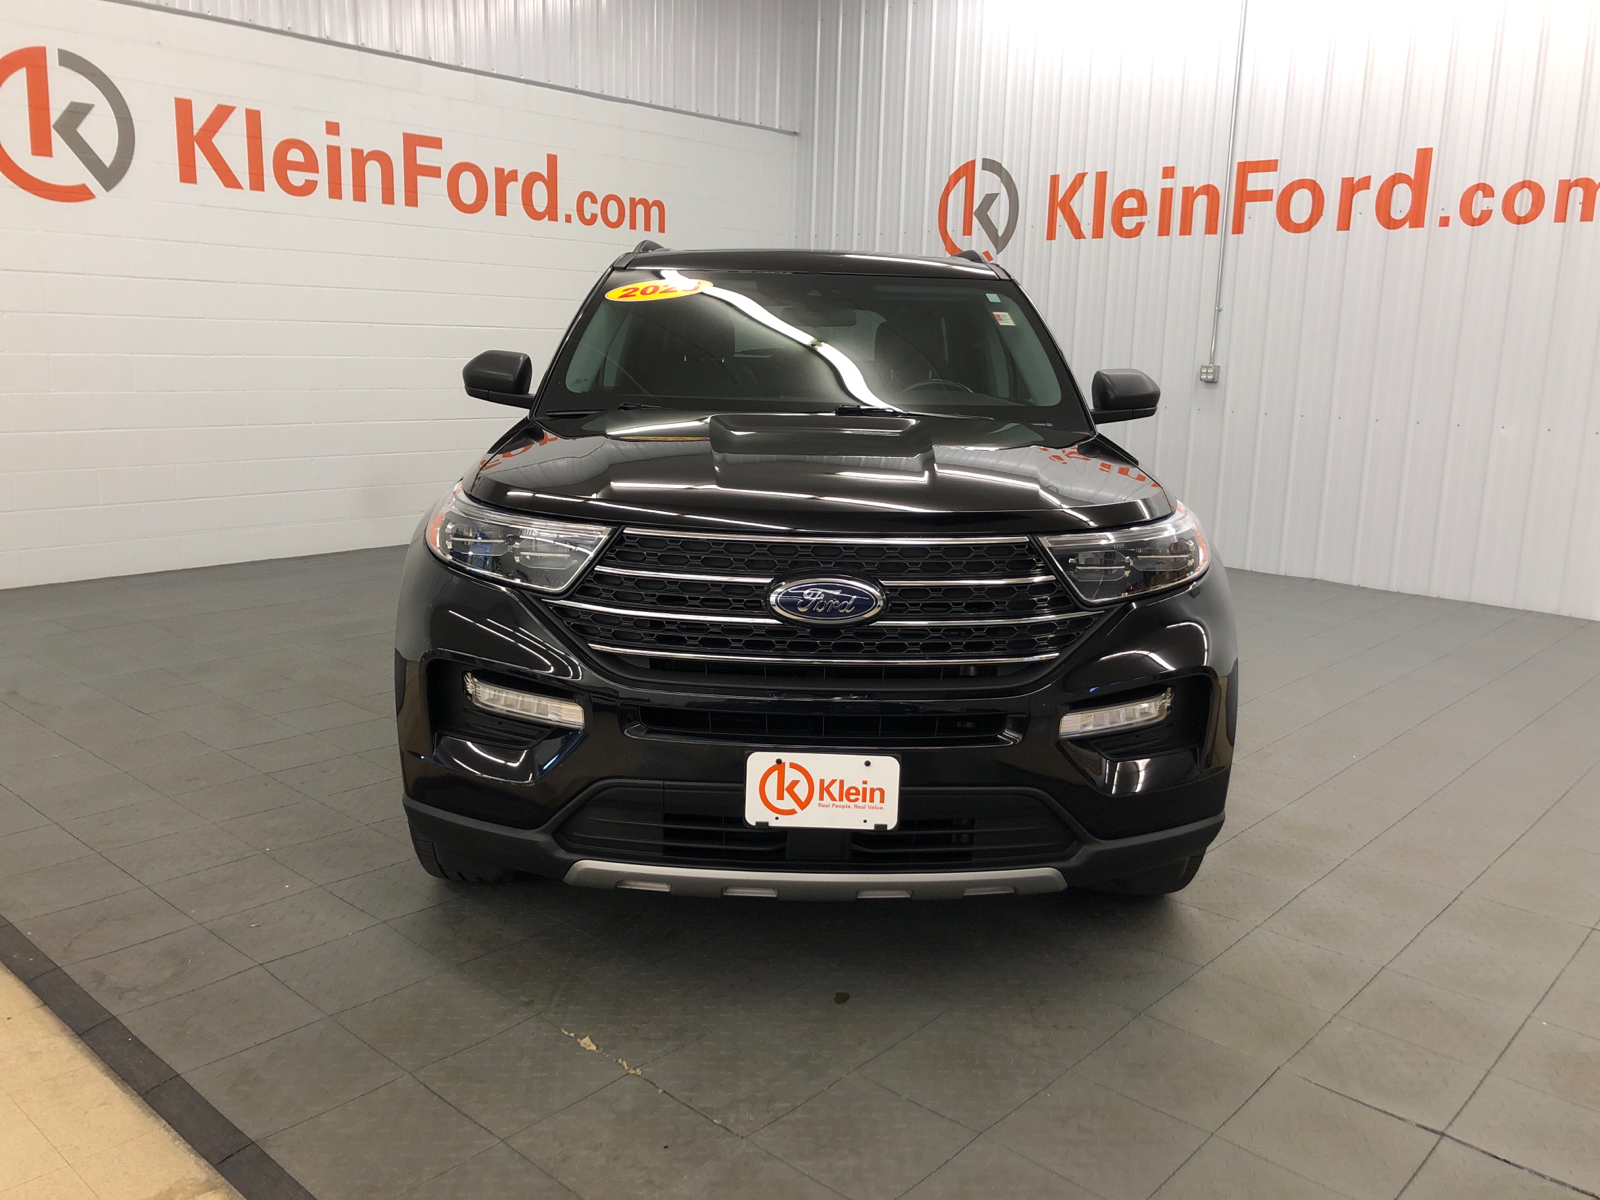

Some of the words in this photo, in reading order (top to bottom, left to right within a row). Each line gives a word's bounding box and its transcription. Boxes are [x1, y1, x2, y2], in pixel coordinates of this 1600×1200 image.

[174, 96, 666, 234] KleinFord.com
[617, 280, 702, 299] 202
[790, 587, 865, 614] Ford
[818, 778, 885, 803] Klein
